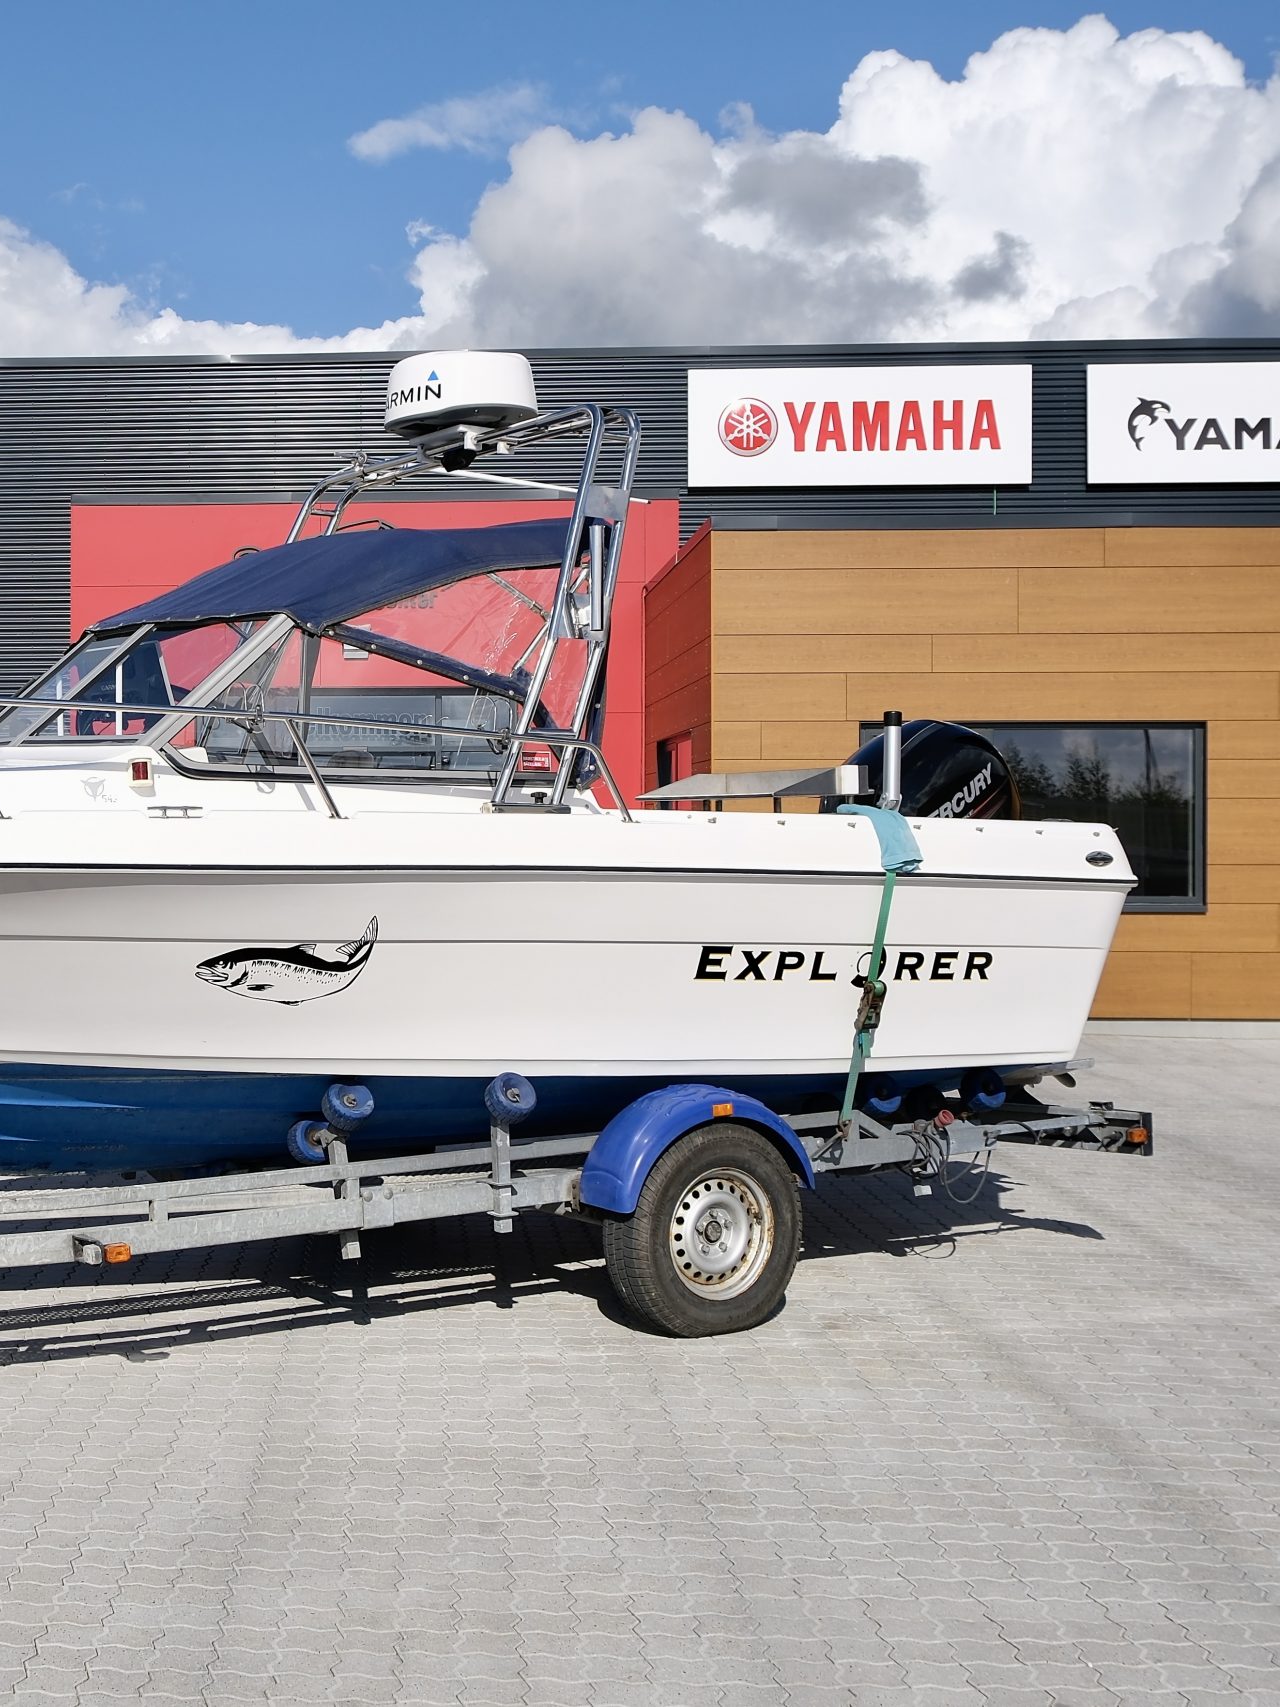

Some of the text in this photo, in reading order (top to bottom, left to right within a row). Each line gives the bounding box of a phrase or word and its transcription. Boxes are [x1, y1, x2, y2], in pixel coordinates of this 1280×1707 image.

[386, 384, 441, 410] RMIN
[783, 399, 1002, 452] YAMAHA
[1164, 417, 1280, 450] YAM
